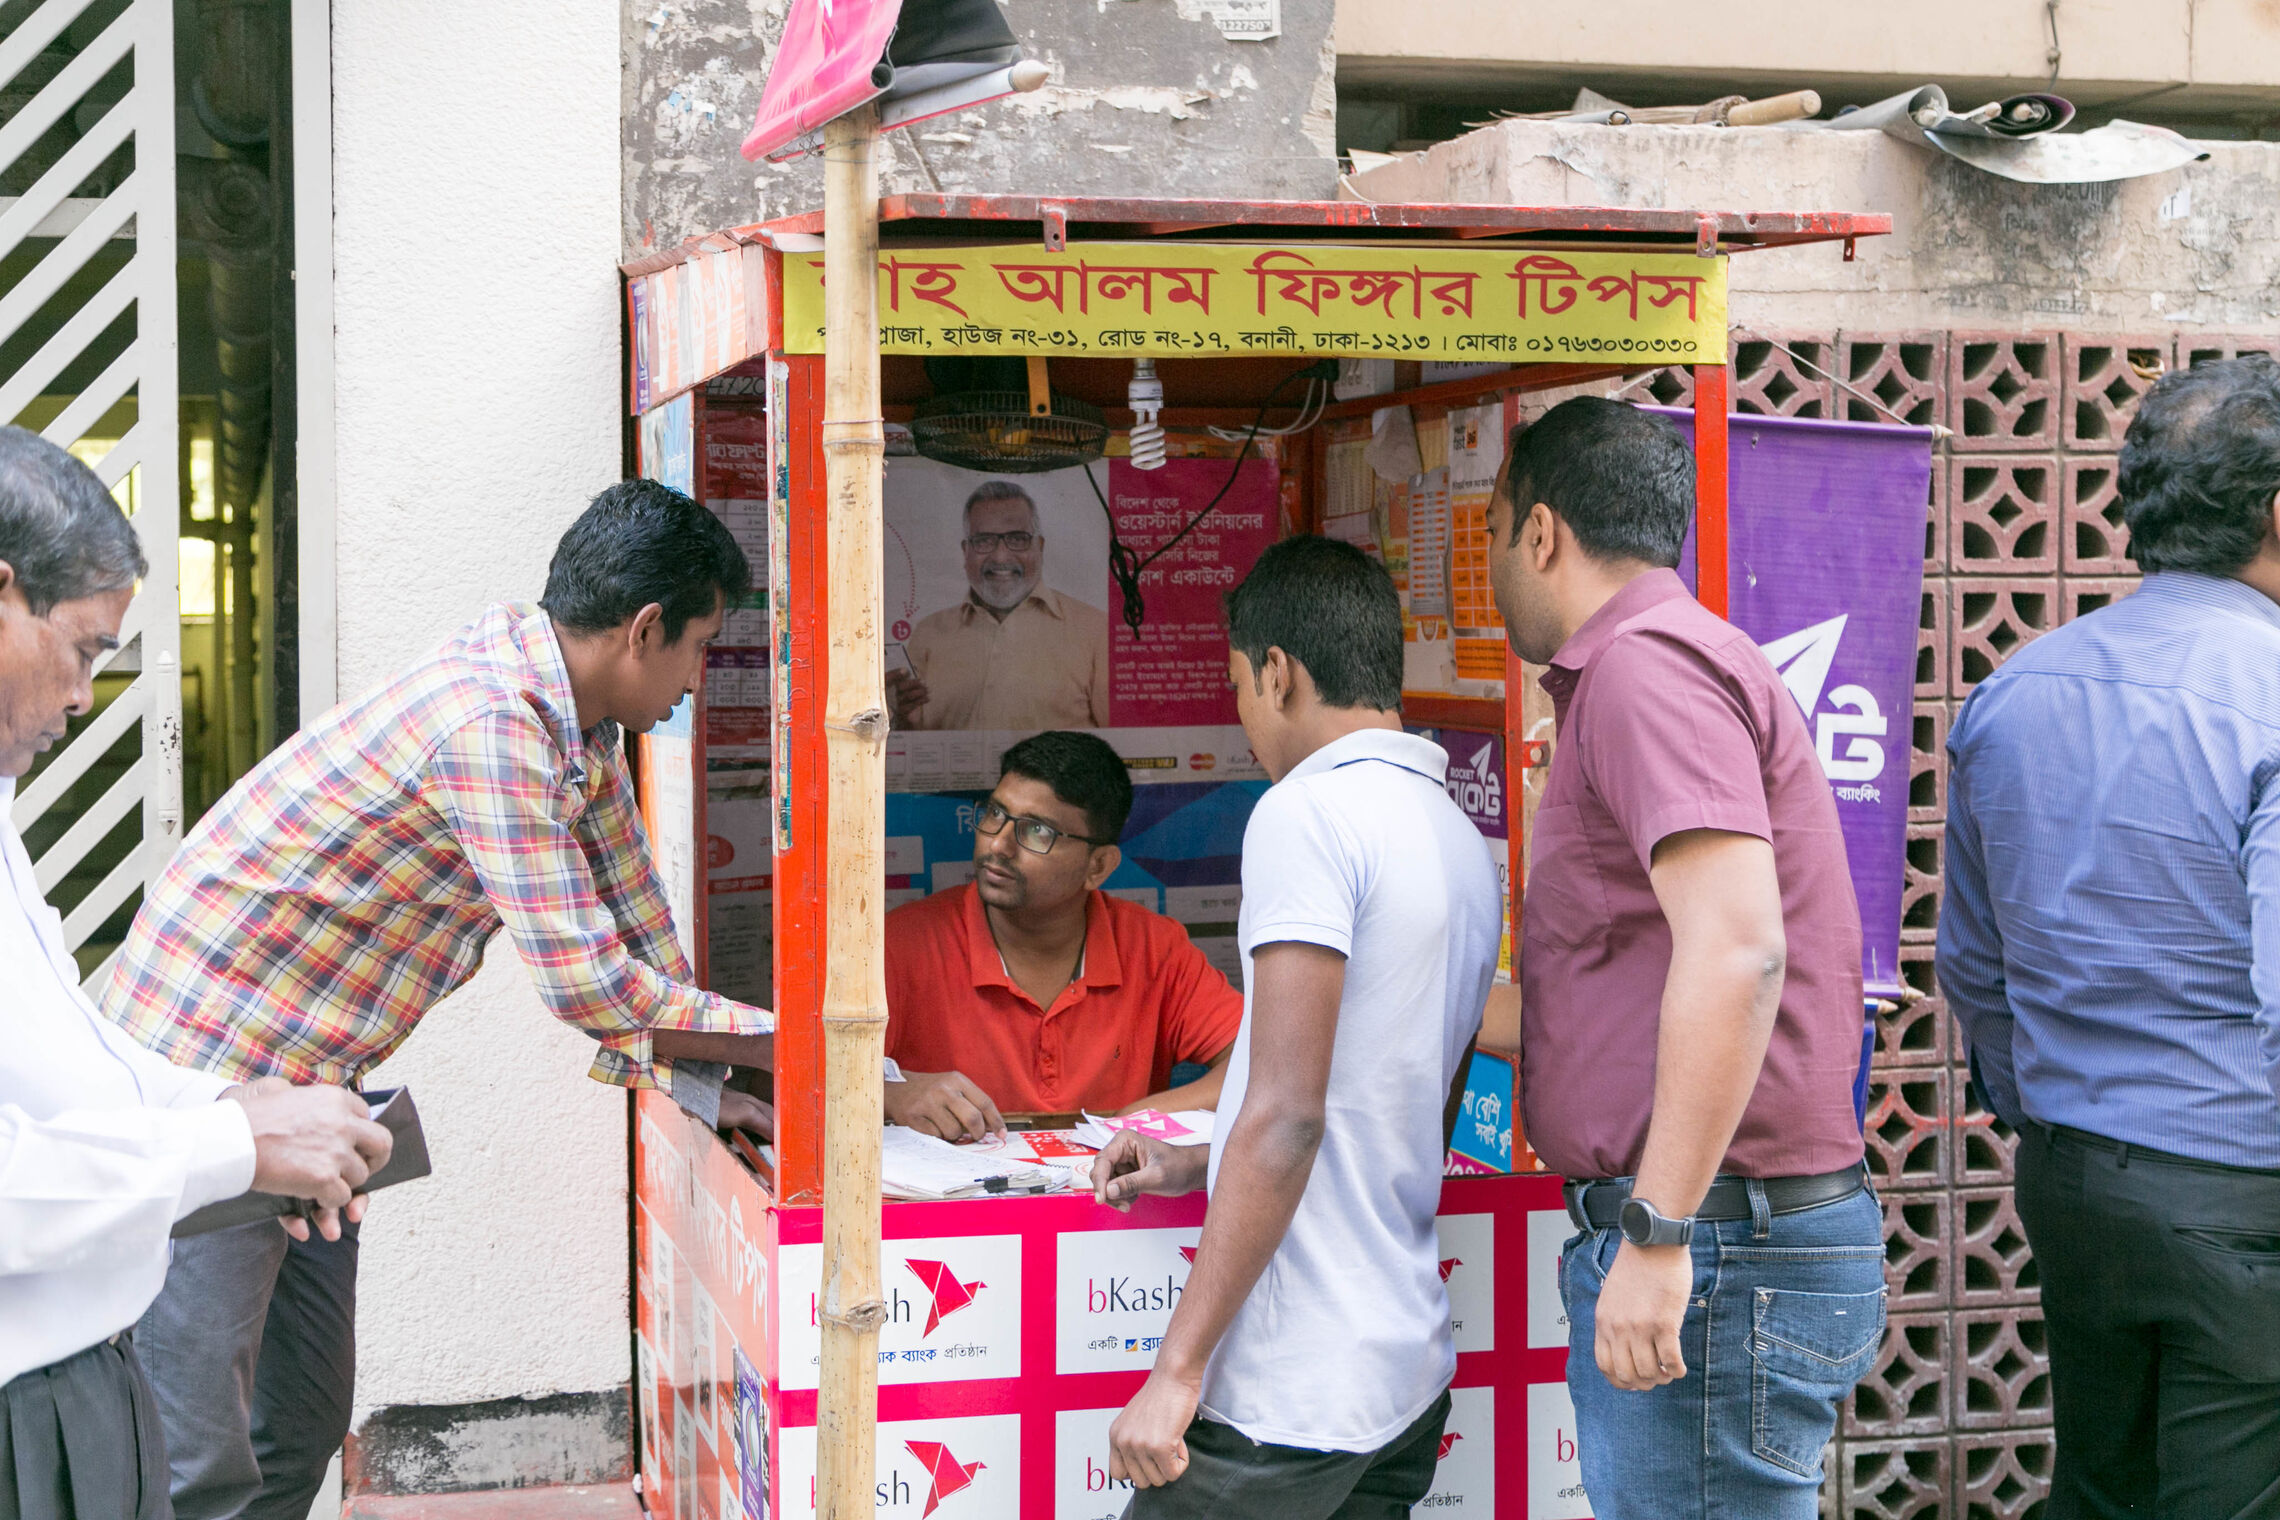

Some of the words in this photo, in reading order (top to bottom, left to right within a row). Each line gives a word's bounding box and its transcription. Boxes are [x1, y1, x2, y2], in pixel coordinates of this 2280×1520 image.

[807, 256, 968, 318] াহ
[991, 258, 1218, 316] আলম
[1244, 250, 1481, 319] ফিঙ্গার
[1505, 255, 1706, 322] টিপস
[941, 323, 1003, 347] হাউজ
[1010, 328, 1088, 350] নং-৩১,
[1098, 329, 1146, 347] রোড
[1154, 331, 1230, 351] নং-১৭,
[1238, 326, 1304, 353] বনানী,
[1313, 331, 1430, 351] ঢাকা-১২১৩
[1456, 333, 1517, 352] মোবাঃ
[1526, 336, 1698, 353] ০১৭৬৩০৩০৩৩০
[1836, 783, 1881, 804] ব্যাংকিং
[1088, 1275, 1184, 1314] bKash
[901, 1349, 938, 1365] ব্যাংক
[943, 1343, 988, 1360] প্রতিষ্ঠান
[1088, 1335, 1119, 1351] একটি
[1422, 1492, 1464, 1508] প্রতিষ্ঠান
